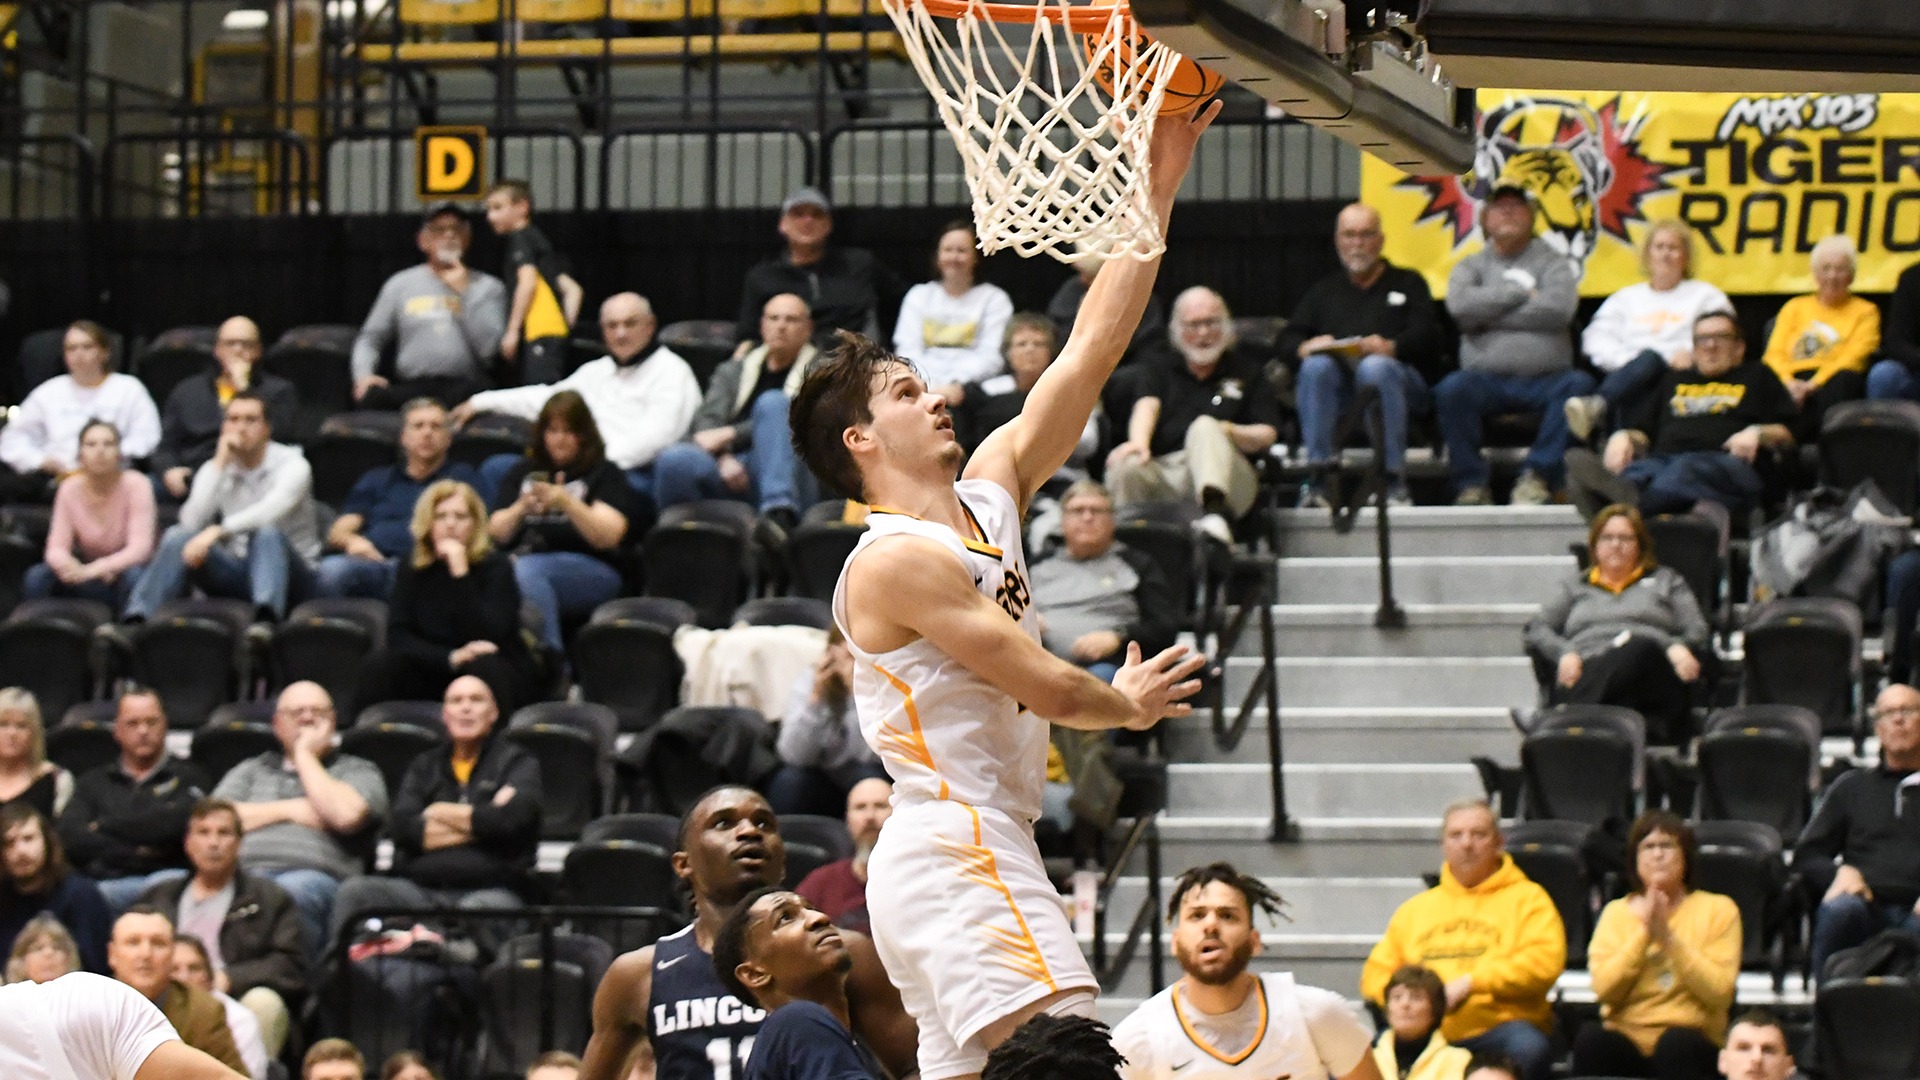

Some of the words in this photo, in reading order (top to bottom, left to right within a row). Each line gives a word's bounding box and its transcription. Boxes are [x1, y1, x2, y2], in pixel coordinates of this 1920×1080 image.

[1810, 92, 1879, 133] 103
[427, 136, 475, 192] D
[1670, 139, 1920, 186] TIGER
[1679, 191, 1920, 255] RADIO
